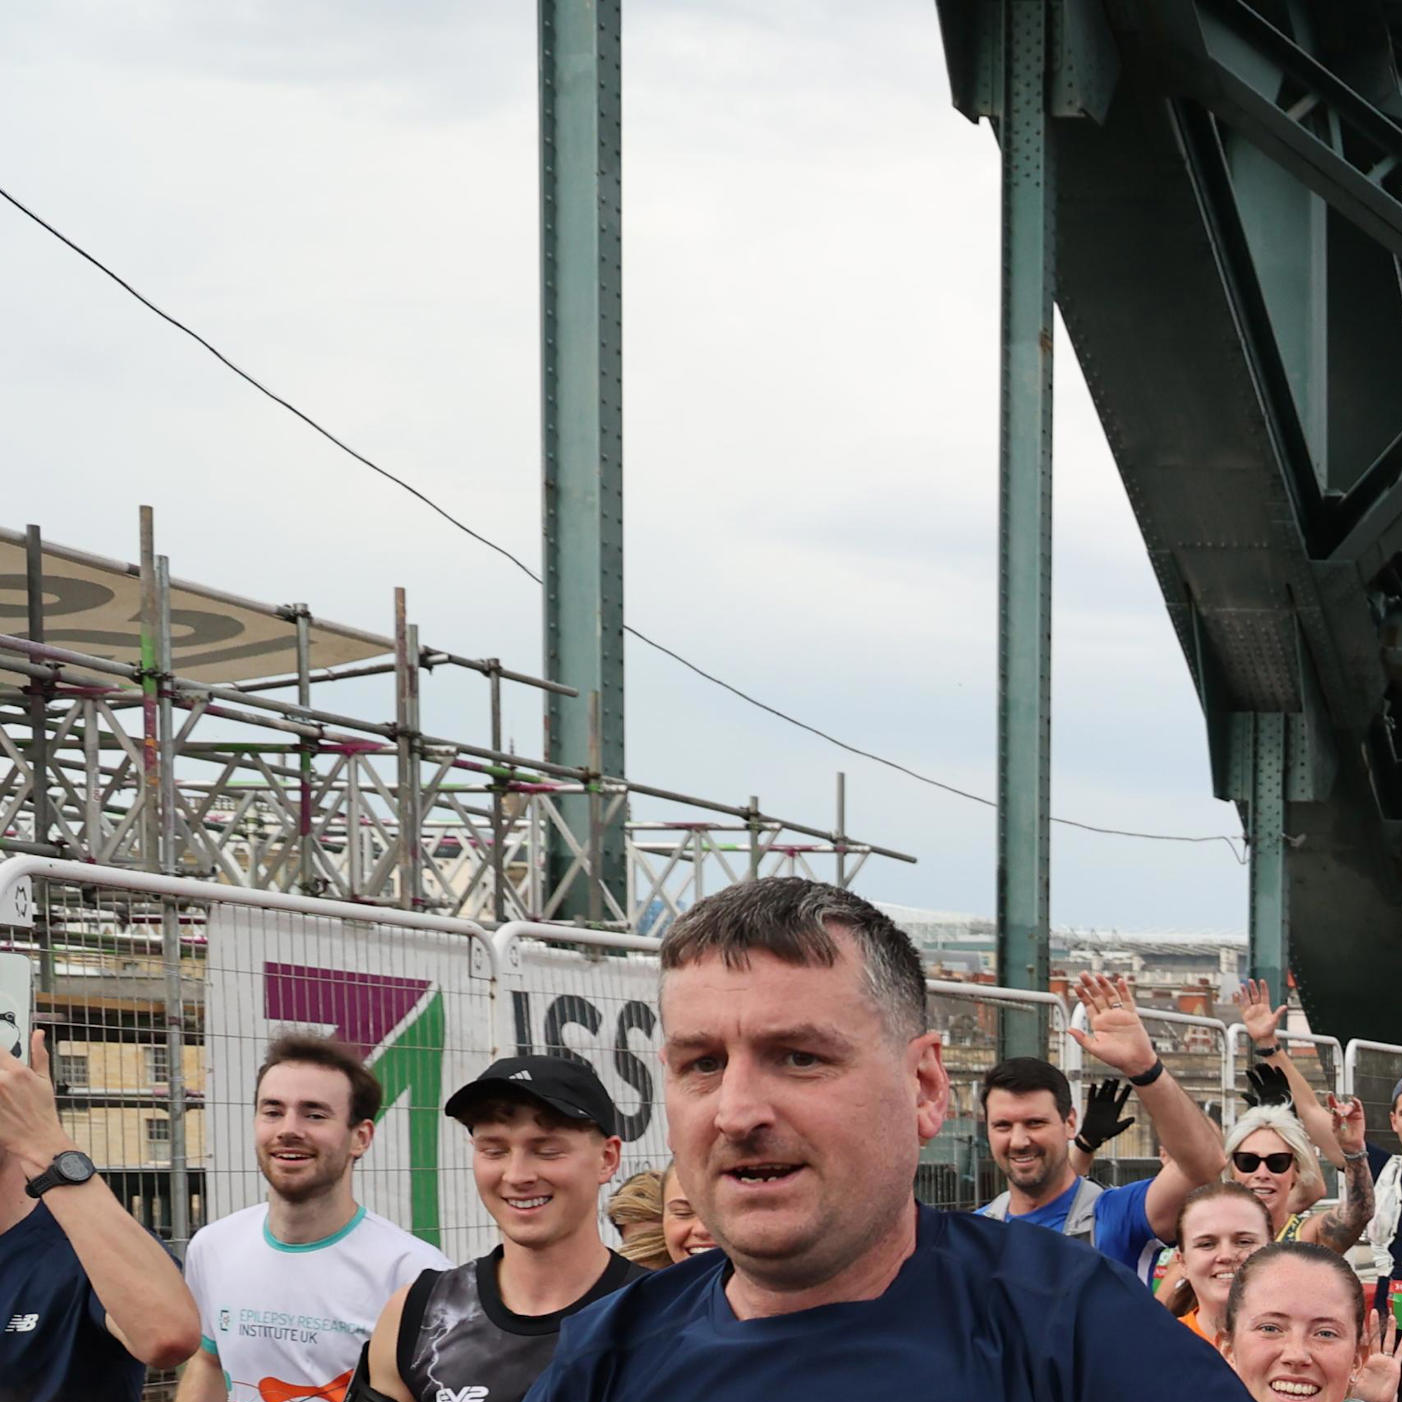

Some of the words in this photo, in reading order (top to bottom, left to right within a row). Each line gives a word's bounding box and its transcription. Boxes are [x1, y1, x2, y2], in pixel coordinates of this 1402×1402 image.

[240, 1309, 294, 1326] EPILEPSY
[239, 1324, 298, 1342] INSTITUTE
[301, 1331, 318, 1344] UK
